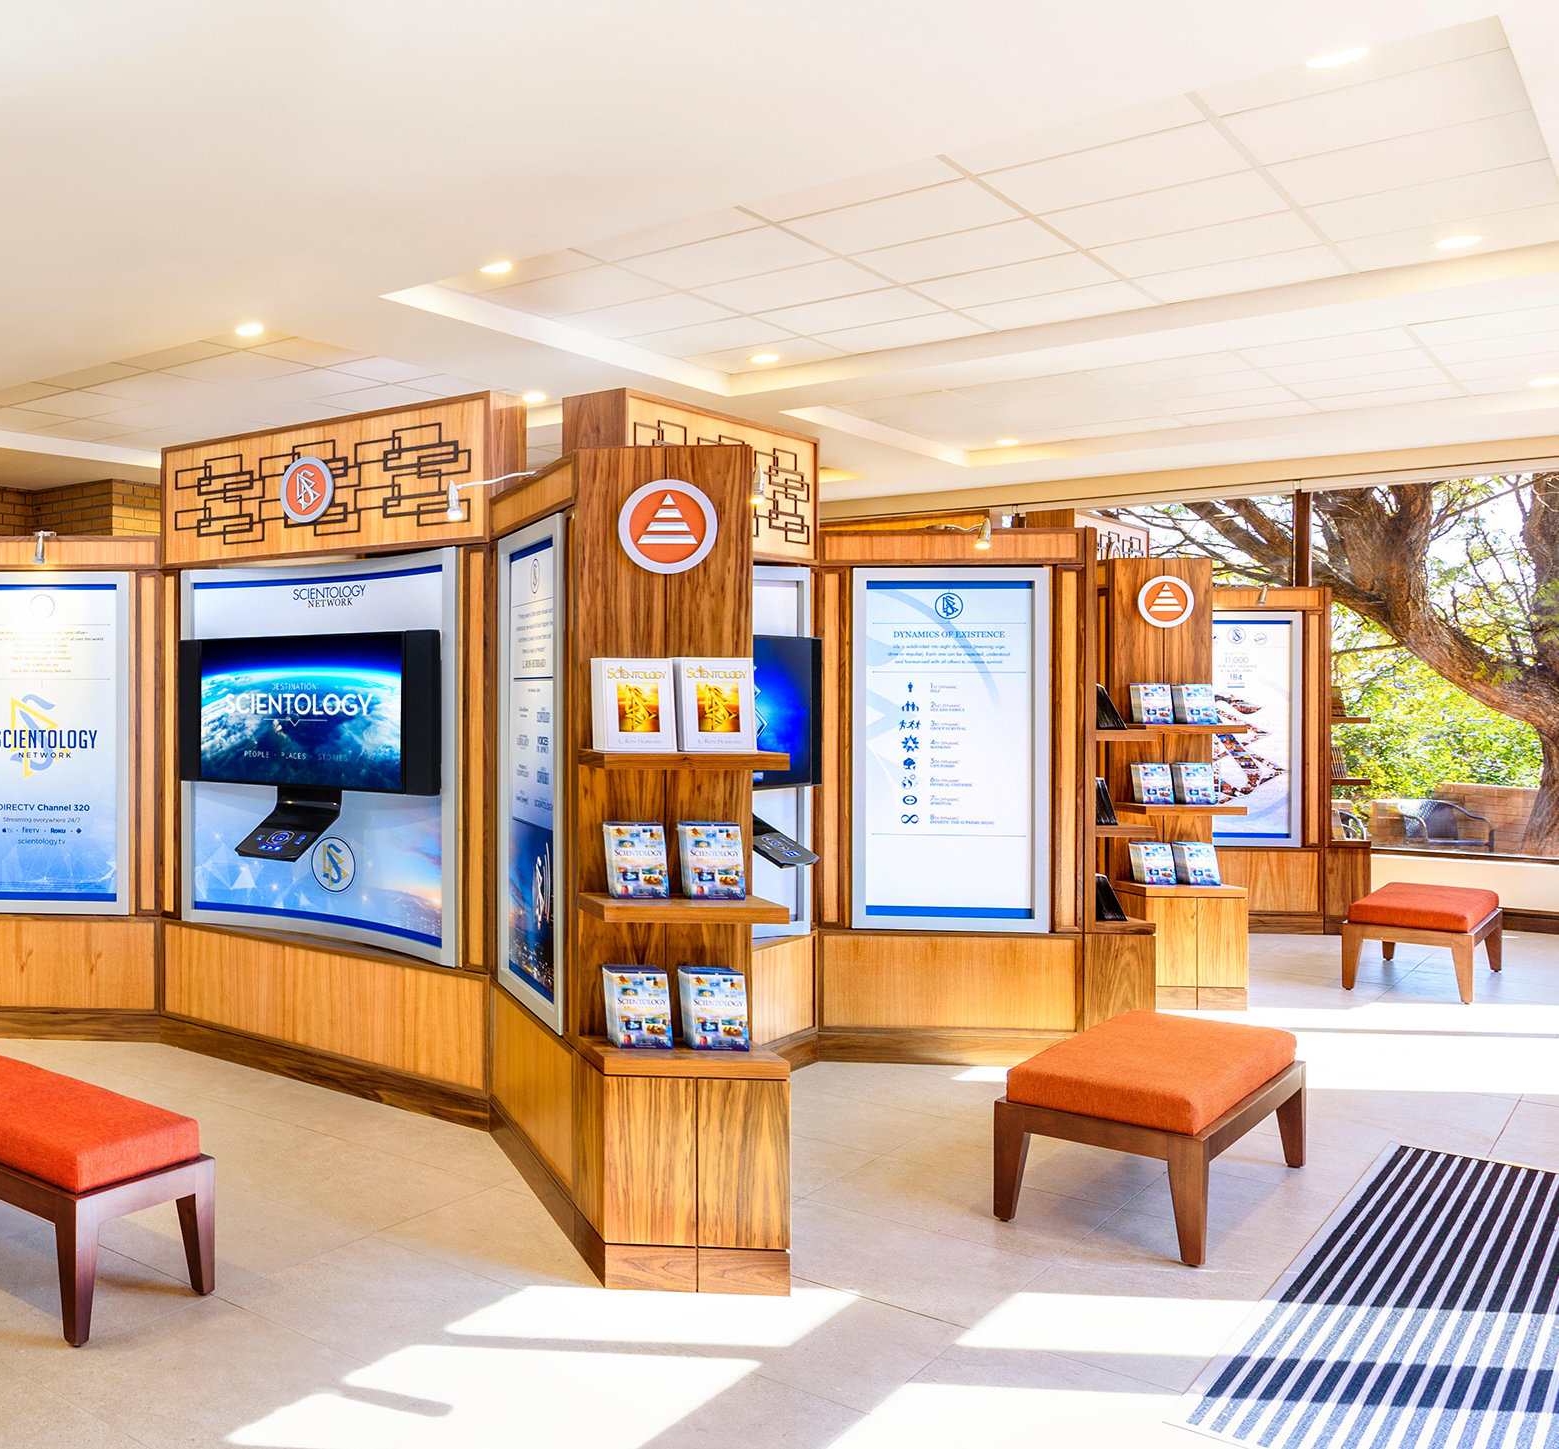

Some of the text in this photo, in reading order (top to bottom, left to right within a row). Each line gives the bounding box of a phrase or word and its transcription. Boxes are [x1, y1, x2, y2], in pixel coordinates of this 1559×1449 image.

[292, 584, 366, 601] SCIENTOLOGY
[308, 597, 353, 608] NETWORK
[607, 666, 666, 679] SCIENTOLOGY
[686, 665, 748, 679] SCIENTOLOGY
[225, 693, 373, 716] SCIENTOLOGY
[18, 751, 72, 759] NETWORK
[243, 750, 269, 759] PEOPLE
[37, 803, 71, 811] Channel
[614, 849, 662, 857] SCIENTOLOGY
[690, 849, 739, 857] SCIENTOLOGY
[617, 997, 667, 1006] SCIENTOLOGY
[693, 999, 744, 1007] SCIENTOLOGY
